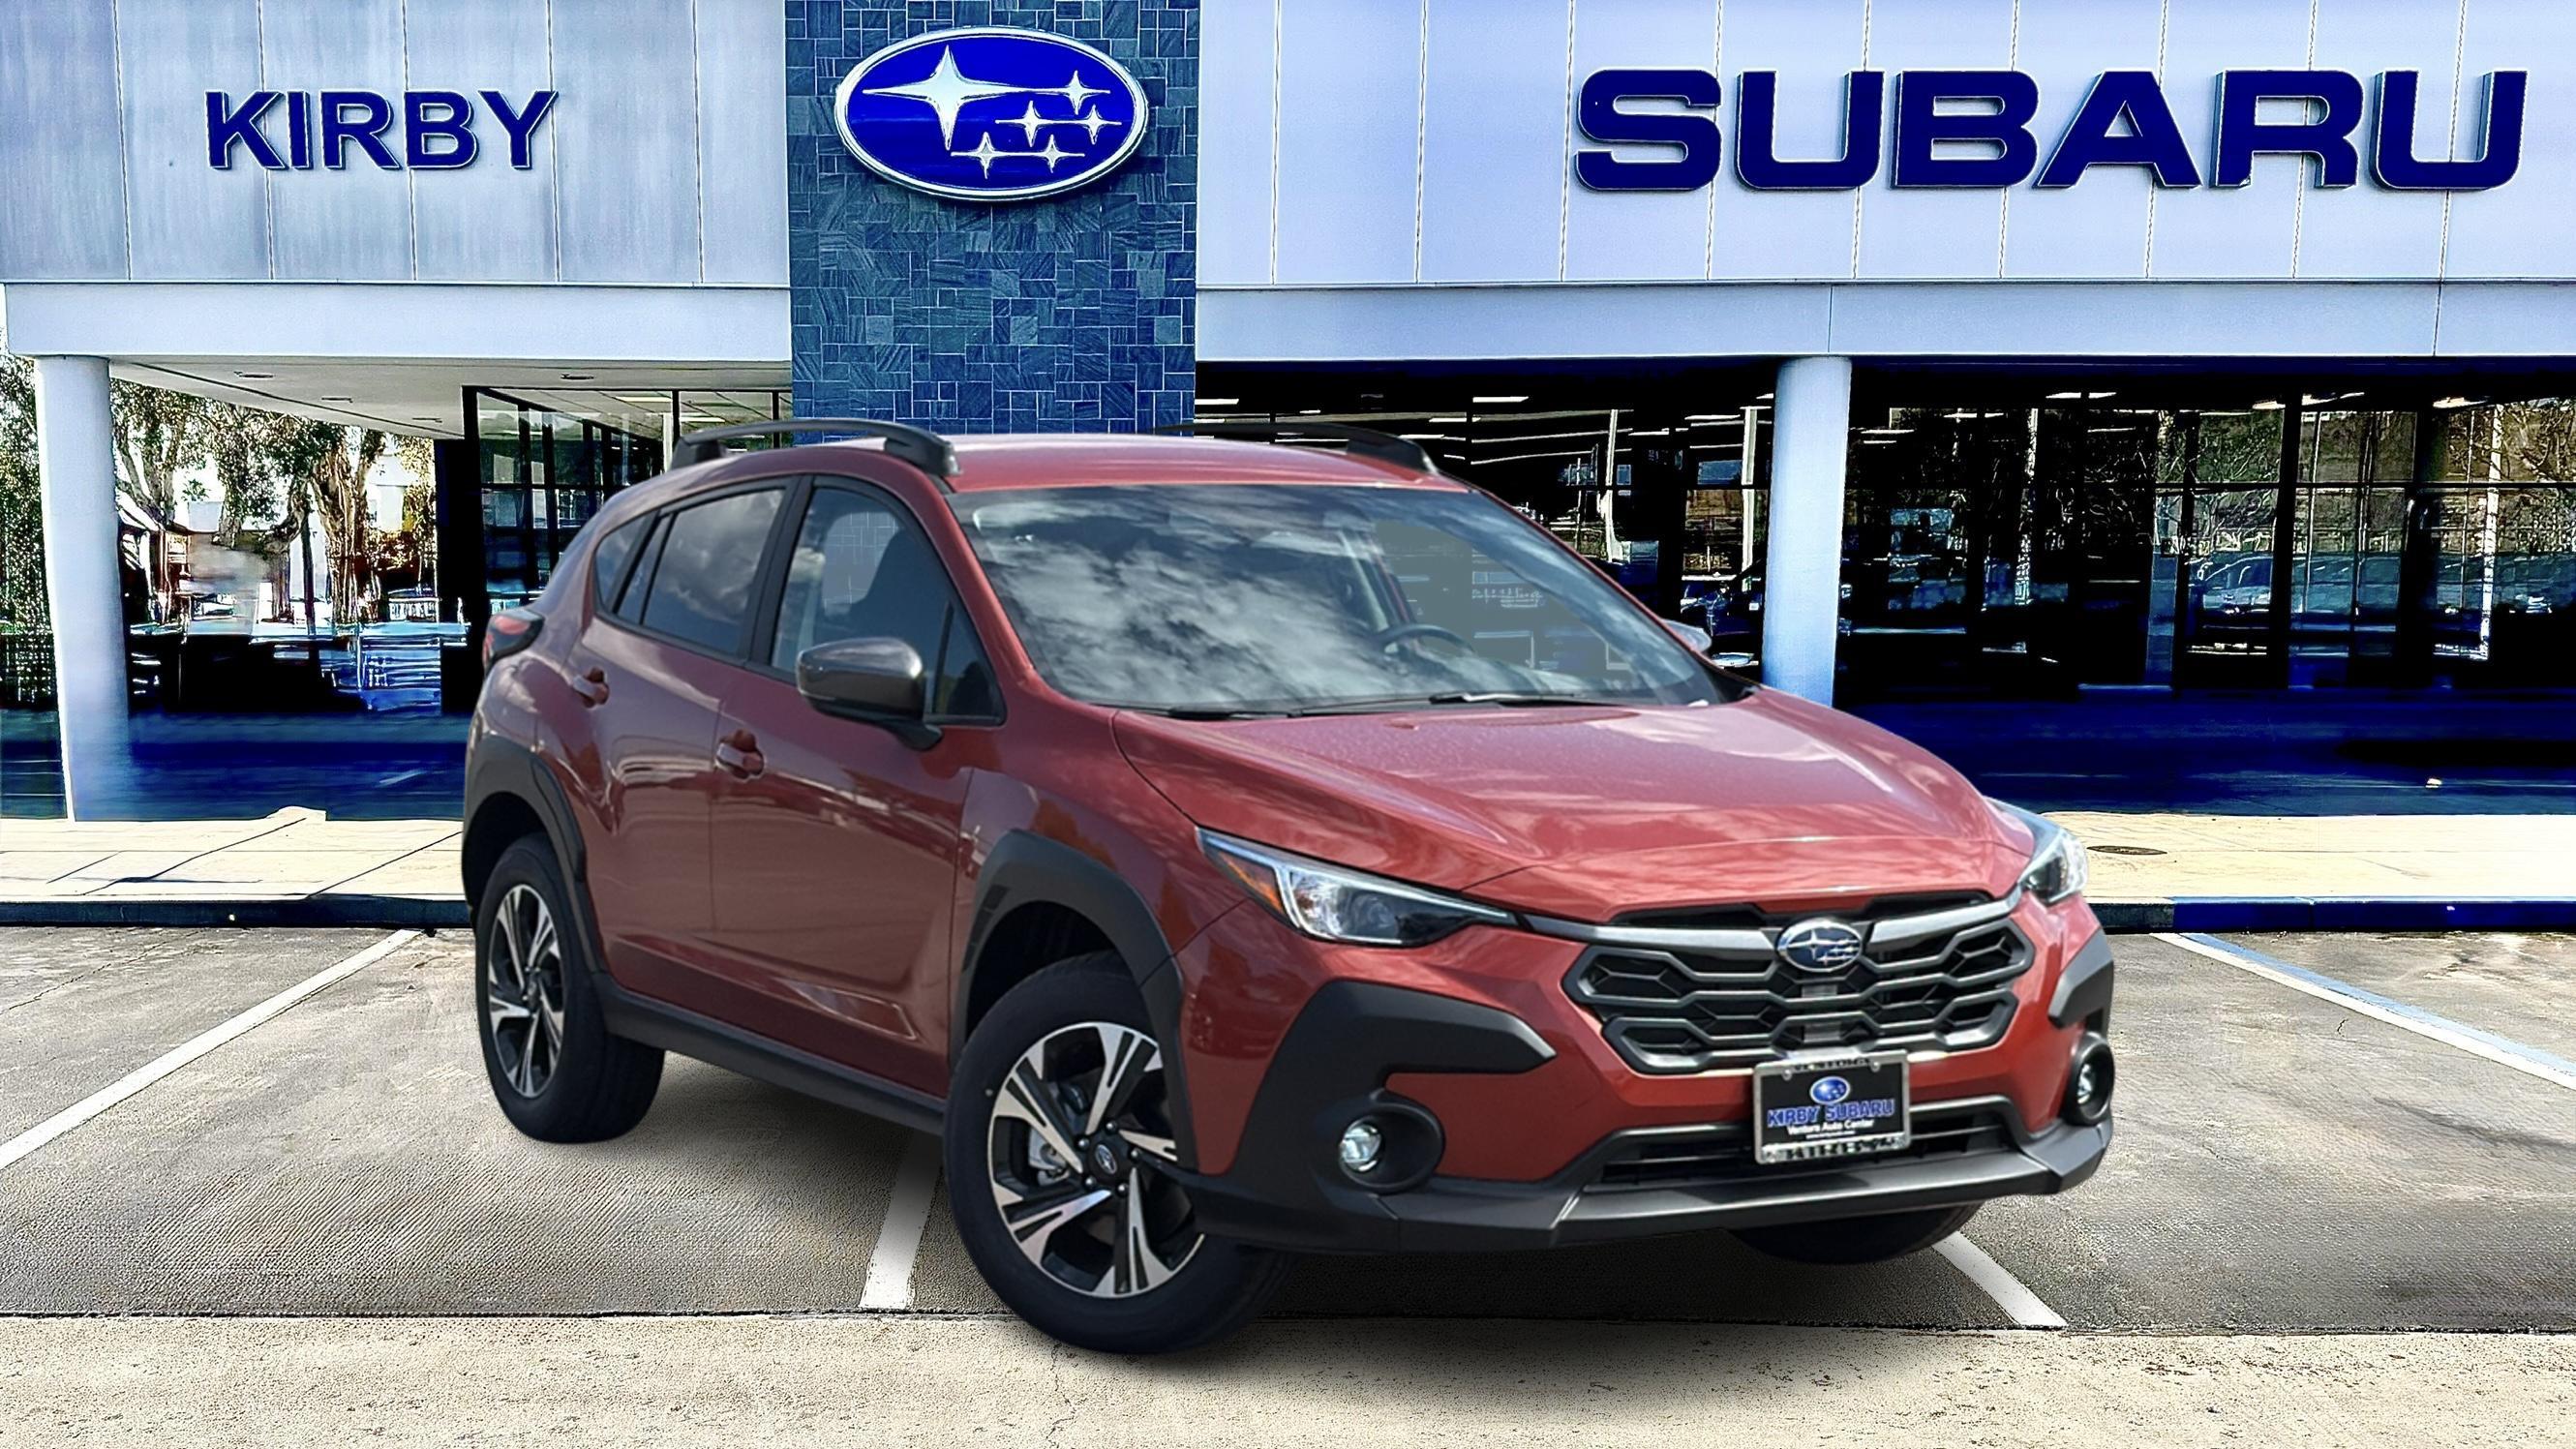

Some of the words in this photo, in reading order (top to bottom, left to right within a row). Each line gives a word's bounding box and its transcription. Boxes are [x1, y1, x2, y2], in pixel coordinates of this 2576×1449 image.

[205, 90, 559, 170] KIRBY
[1575, 70, 2527, 193] SUBARU
[1768, 1106, 1820, 1127] KIRBY
[1825, 1100, 1894, 1121] SUBARU
[1822, 1121, 1842, 1132] Auto
[1844, 1119, 1874, 1130] Center
